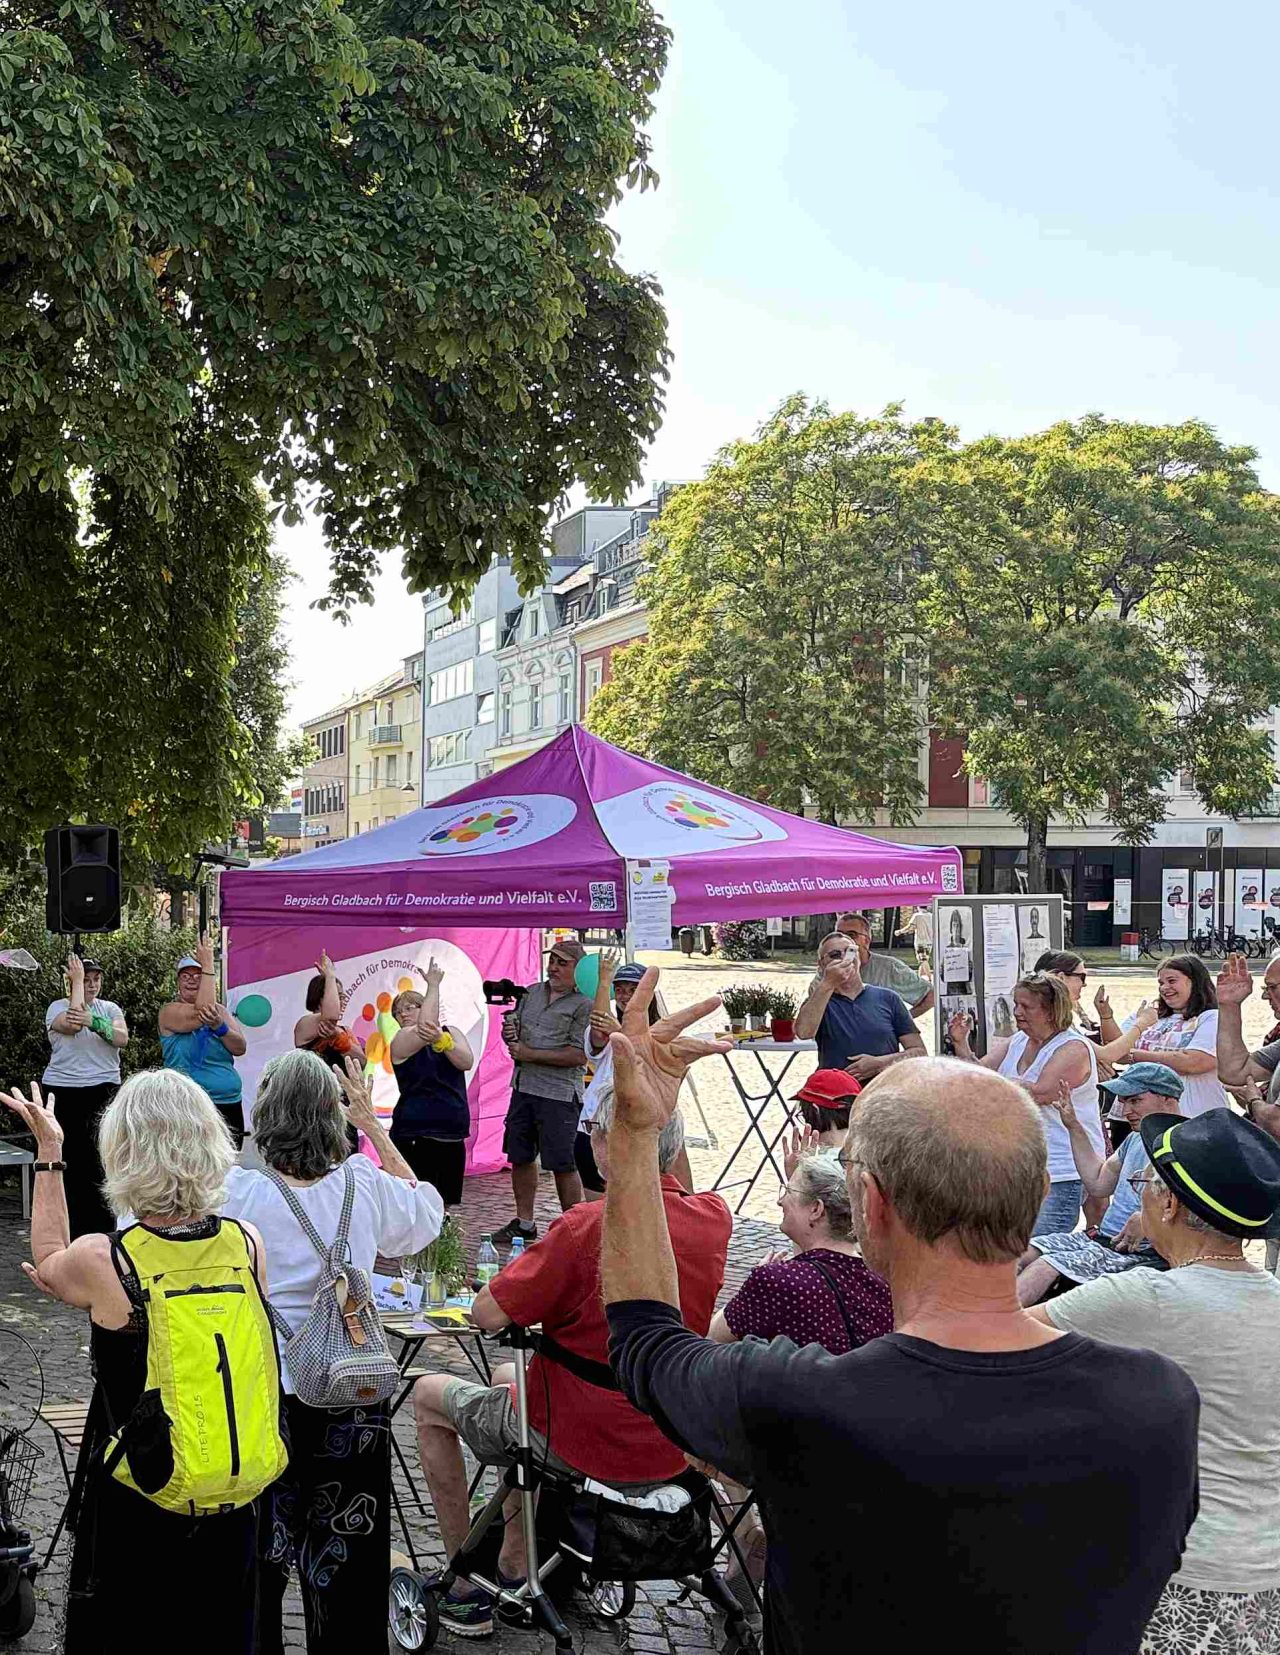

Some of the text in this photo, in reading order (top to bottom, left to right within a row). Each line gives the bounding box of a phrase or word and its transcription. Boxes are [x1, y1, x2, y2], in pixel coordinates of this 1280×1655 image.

[704, 871, 937, 899] Bergisch Gladbach für Demokratie und Vielfalt e.V.
[283, 889, 582, 908] Bergisch Gladbach für Demokratie und Vielfalt e.V.
[366, 963, 380, 976] für
[381, 959, 420, 974] Demokra
[196, 1411, 207, 1436] PRO
[200, 1437, 210, 1463] LITE
